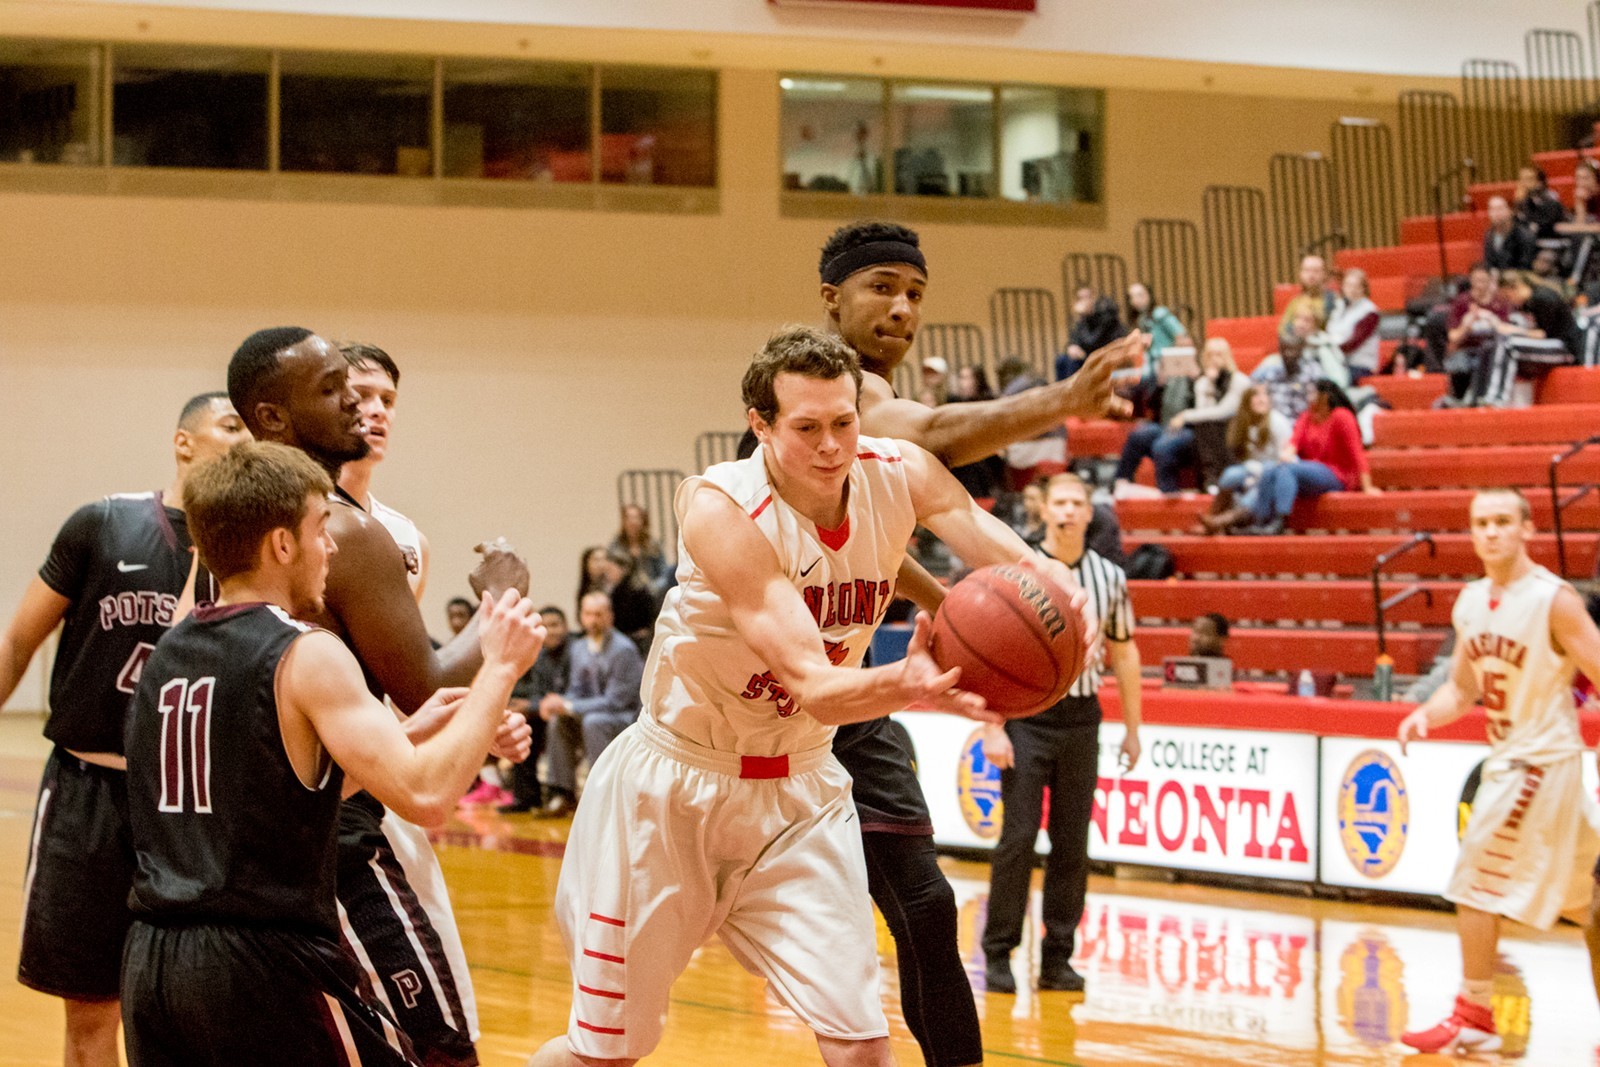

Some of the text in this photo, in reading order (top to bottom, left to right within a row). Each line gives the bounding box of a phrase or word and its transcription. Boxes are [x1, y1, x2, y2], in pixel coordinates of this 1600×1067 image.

[99, 591, 178, 630] POTS
[158, 676, 216, 813] 11
[1151, 740, 1236, 772] COLLEGE
[1245, 747, 1269, 775] AT
[1088, 776, 1309, 863] NEONTA
[390, 968, 423, 1009] P
